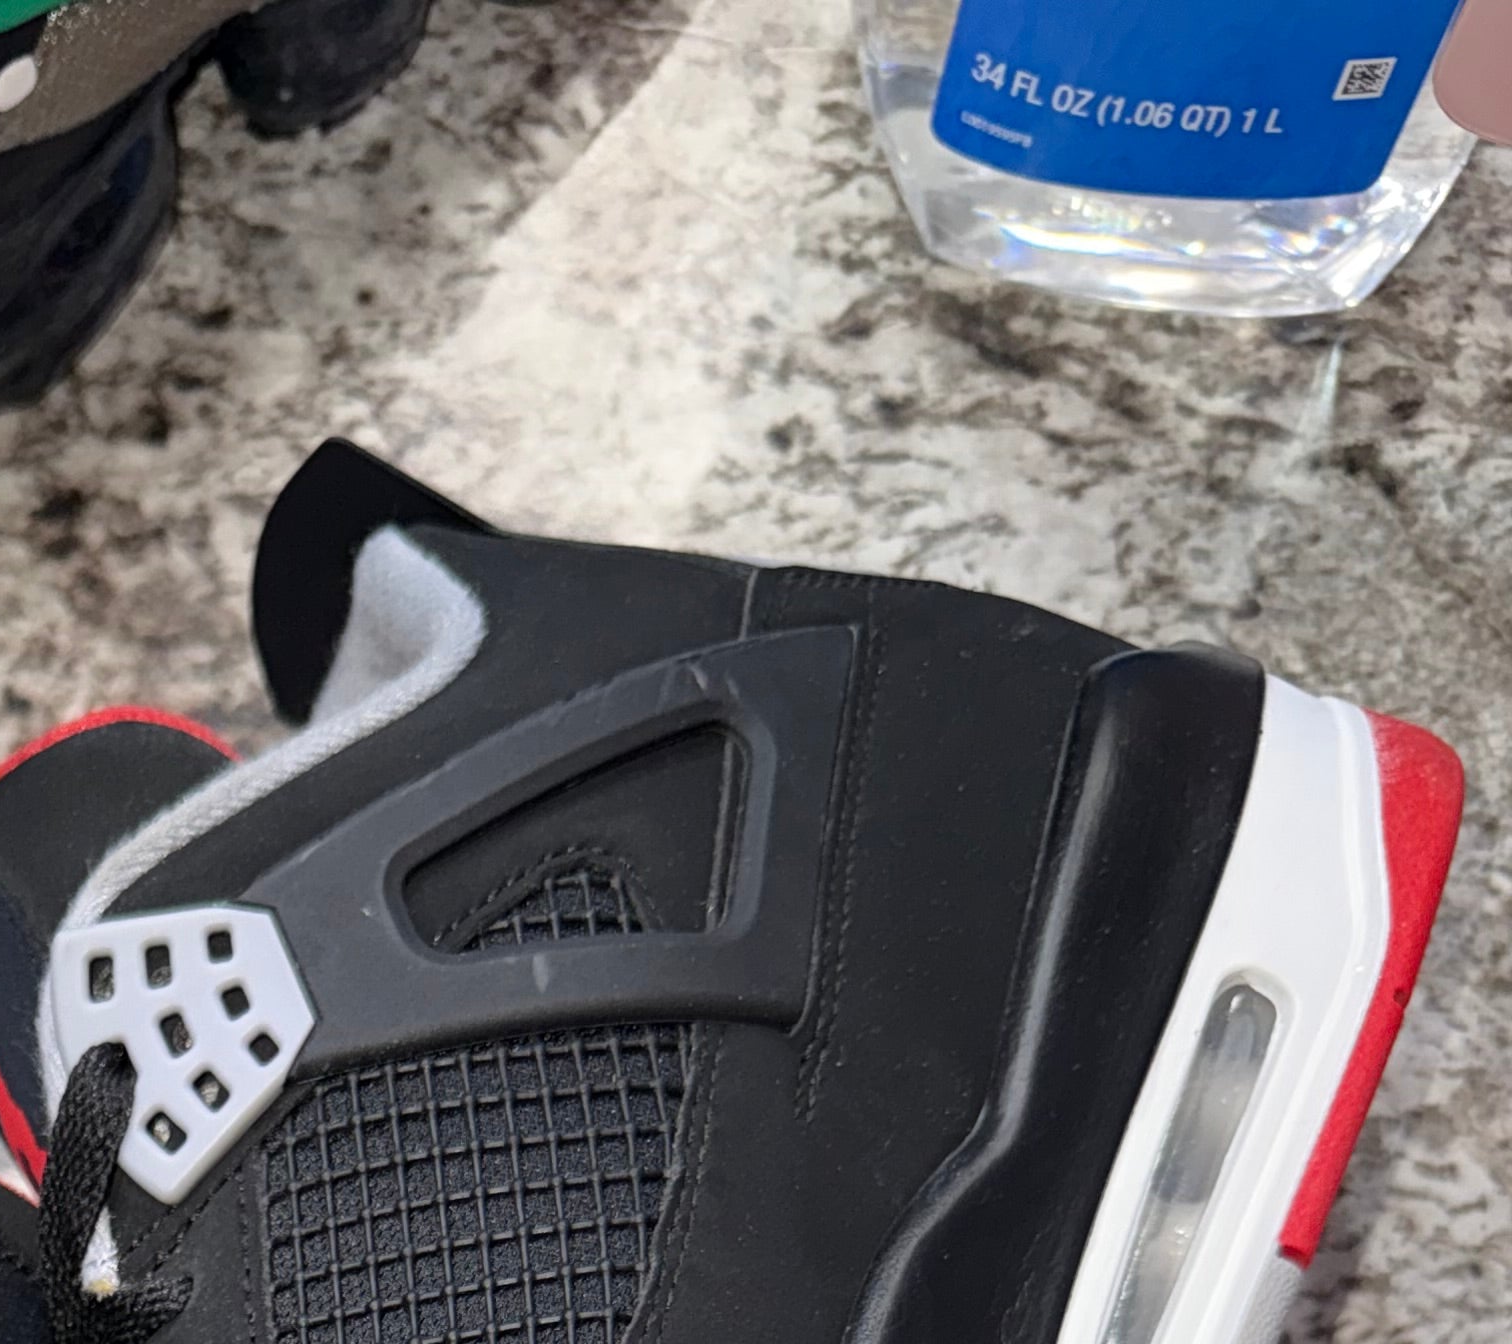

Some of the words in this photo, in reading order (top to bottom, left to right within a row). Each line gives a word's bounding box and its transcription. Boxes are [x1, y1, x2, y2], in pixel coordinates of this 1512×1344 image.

[971, 53, 1007, 91] 34
[1010, 69, 1043, 106] FL
[1051, 84, 1096, 118] OZ
[1097, 95, 1175, 128] (1.06
[1180, 104, 1232, 138] QT)
[1242, 108, 1257, 134] 1
[1264, 108, 1283, 134] L
